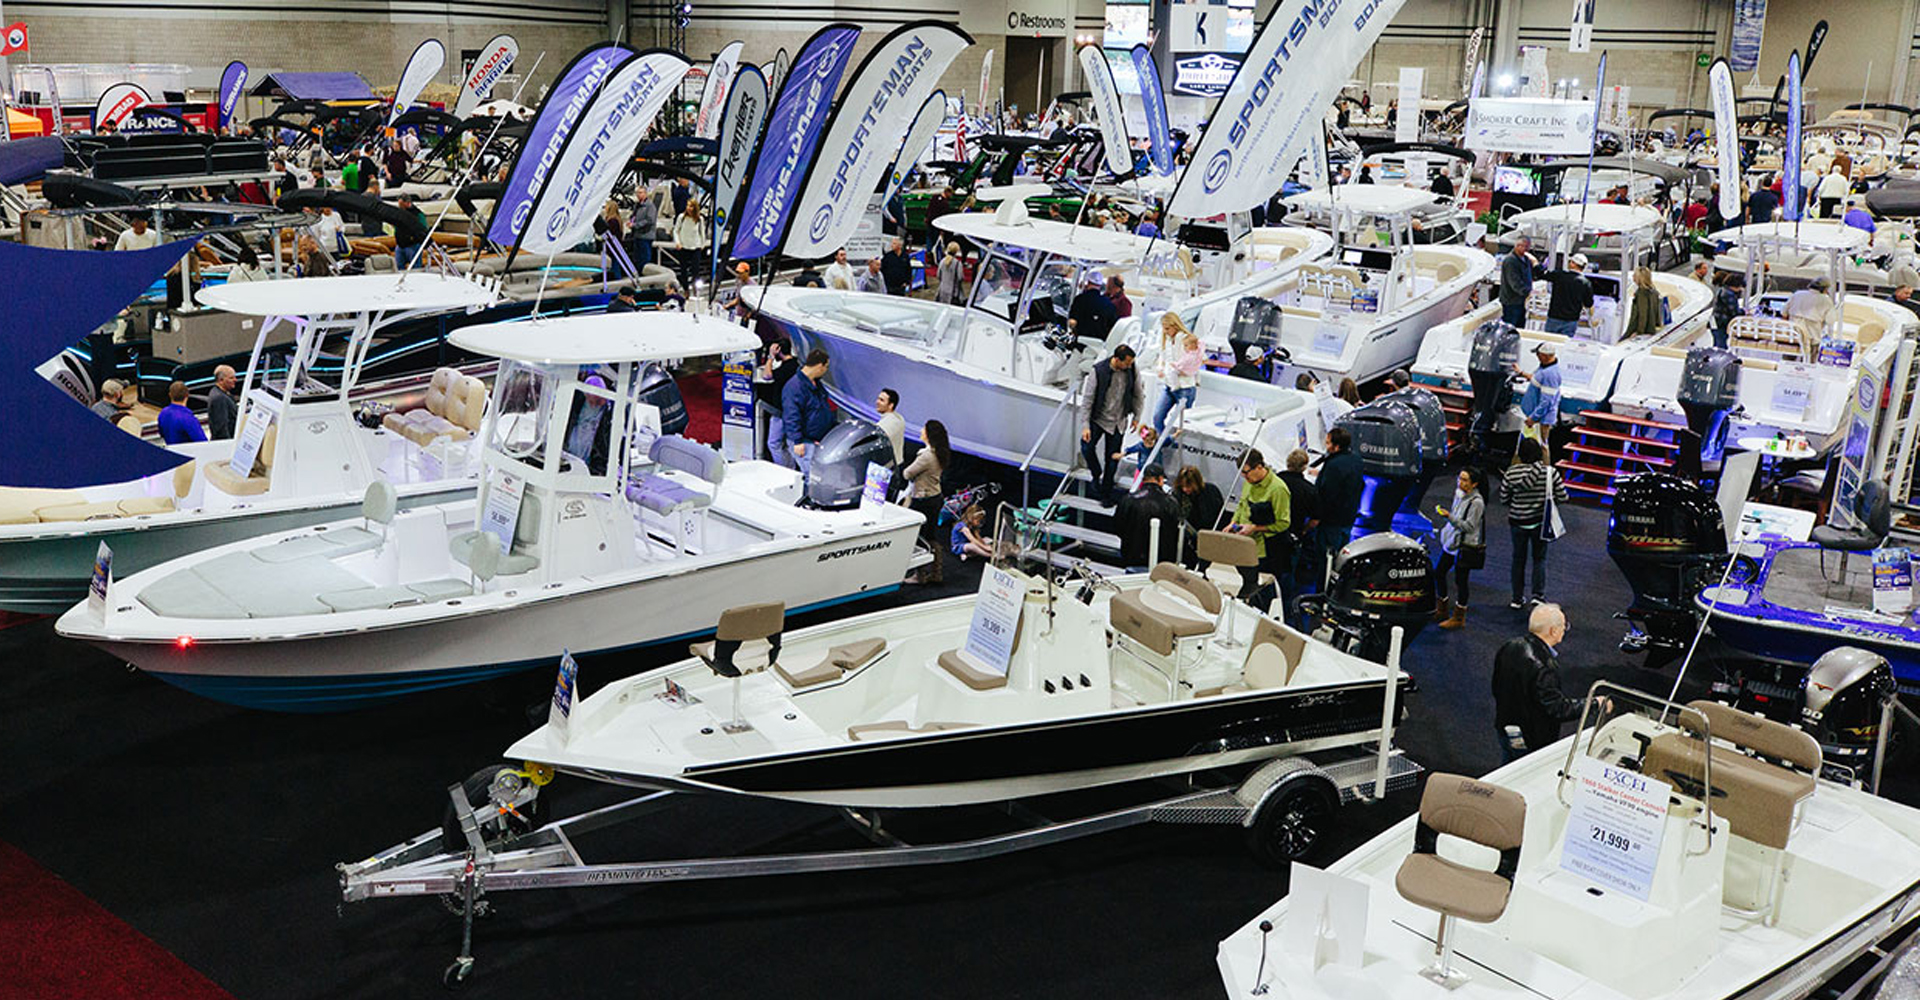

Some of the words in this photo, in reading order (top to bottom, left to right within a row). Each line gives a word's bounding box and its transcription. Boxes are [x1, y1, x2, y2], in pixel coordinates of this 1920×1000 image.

[1019, 12, 1066, 29] Restrooms
[468, 46, 508, 89] HONDA
[474, 52, 515, 97] MARINE
[897, 47, 933, 97] BOATS
[222, 70, 247, 116] LOWRANCE
[631, 73, 661, 117] BOATS
[527, 56, 608, 200] SPORTSMAN
[565, 62, 655, 206] SPORTSMAN
[828, 35, 925, 203] SPORTSMAN
[761, 78, 823, 247] SPORTSMAN
[1369, 444, 1399, 455] YAMAHA
[817, 541, 892, 562] SPORTSMAN
[1399, 568, 1426, 578] YAMAHA
[1604, 768, 1648, 793] EXCEL
